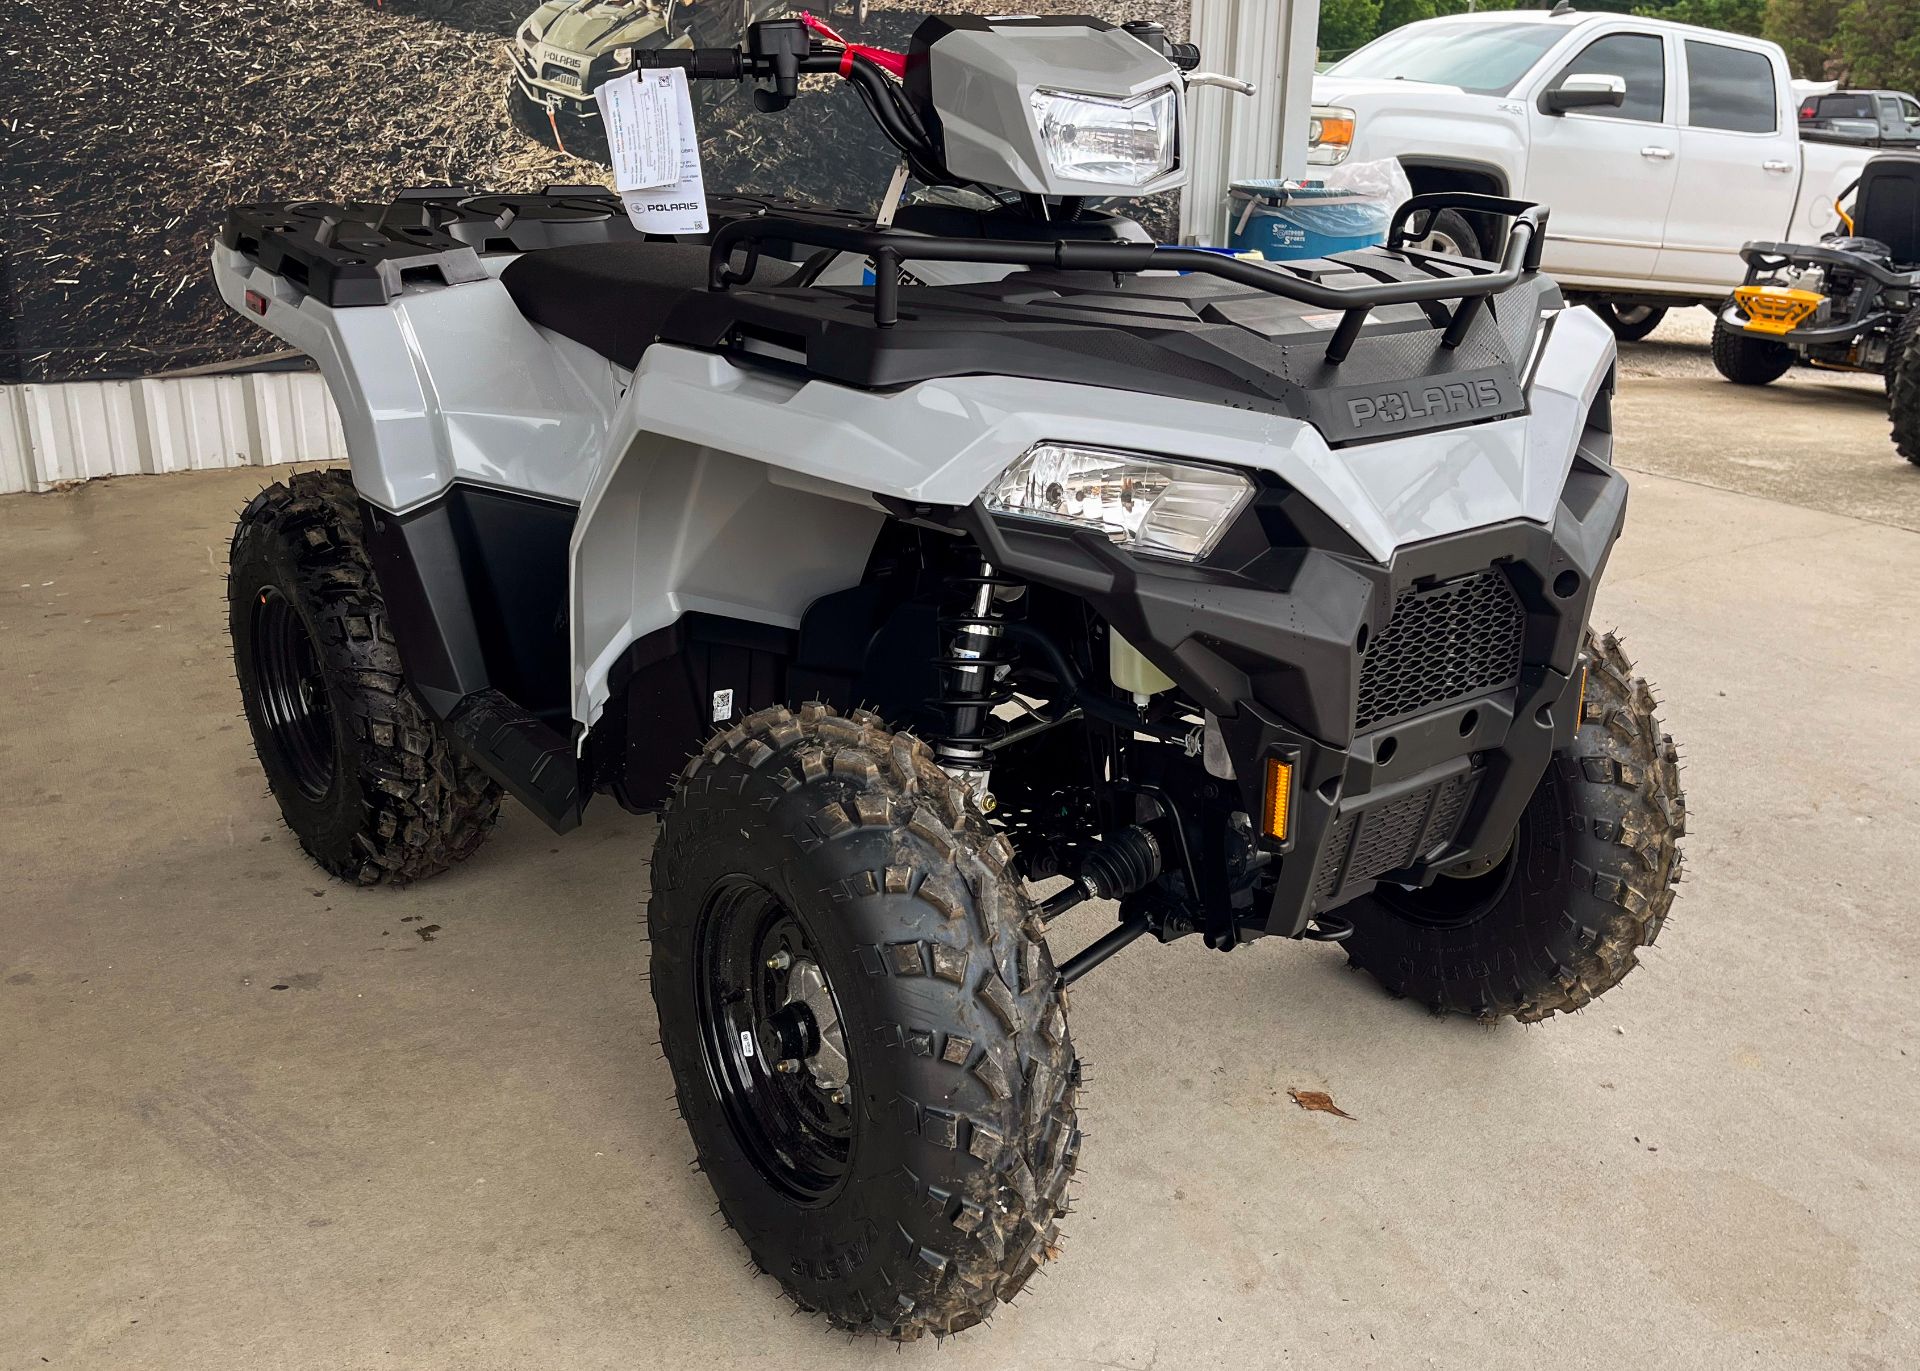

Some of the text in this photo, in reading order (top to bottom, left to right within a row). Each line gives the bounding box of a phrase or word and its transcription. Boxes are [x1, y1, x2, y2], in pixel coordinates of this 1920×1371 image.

[544, 51, 581, 68] POLARIS
[647, 202, 698, 212] POLARIS
[1347, 379, 1502, 428] POLARIS
